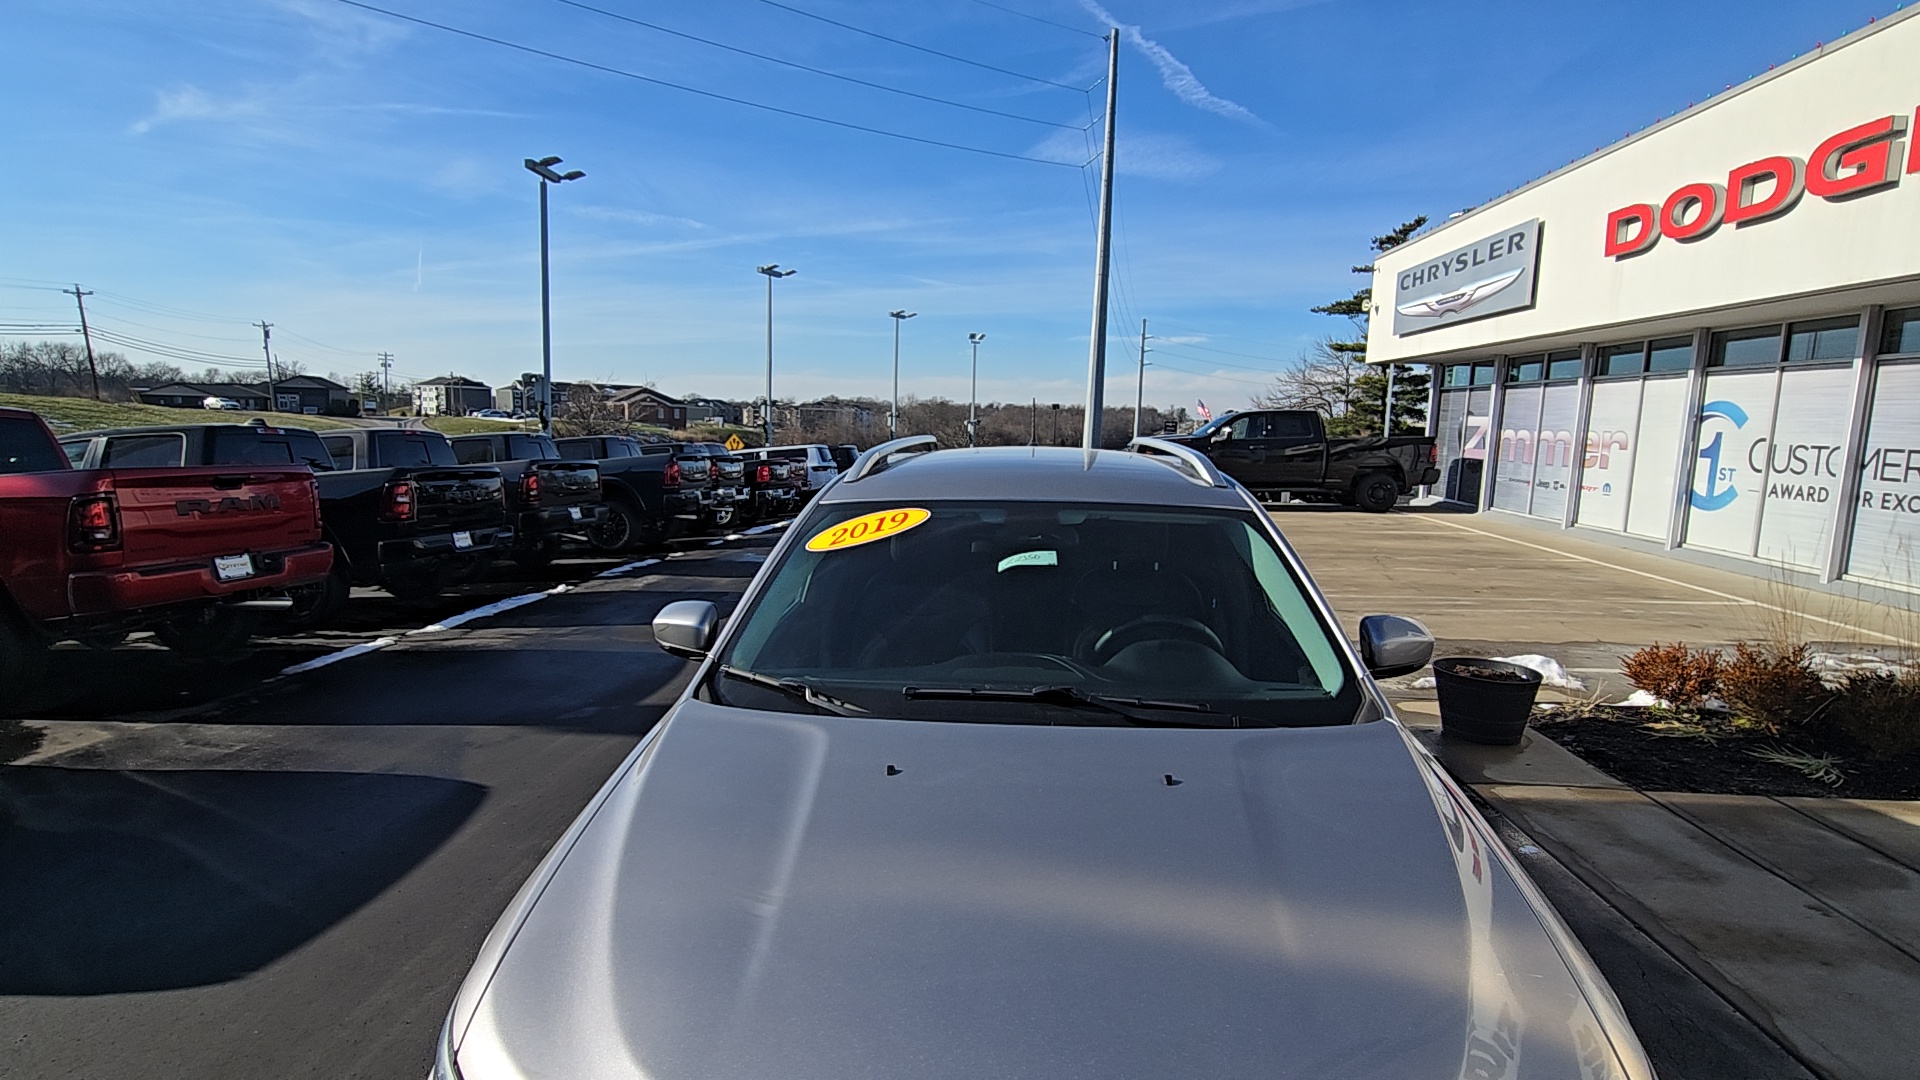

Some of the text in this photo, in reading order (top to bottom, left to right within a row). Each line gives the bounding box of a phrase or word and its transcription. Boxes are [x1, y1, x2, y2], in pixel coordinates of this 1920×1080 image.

[1604, 104, 1920, 262] DODG
[1400, 231, 1526, 291] CHRYSLER
[1463, 416, 1628, 470] Zmmer
[176, 494, 282, 517] RAM
[1768, 483, 1830, 504] AWARD
[828, 511, 909, 547] 2019
